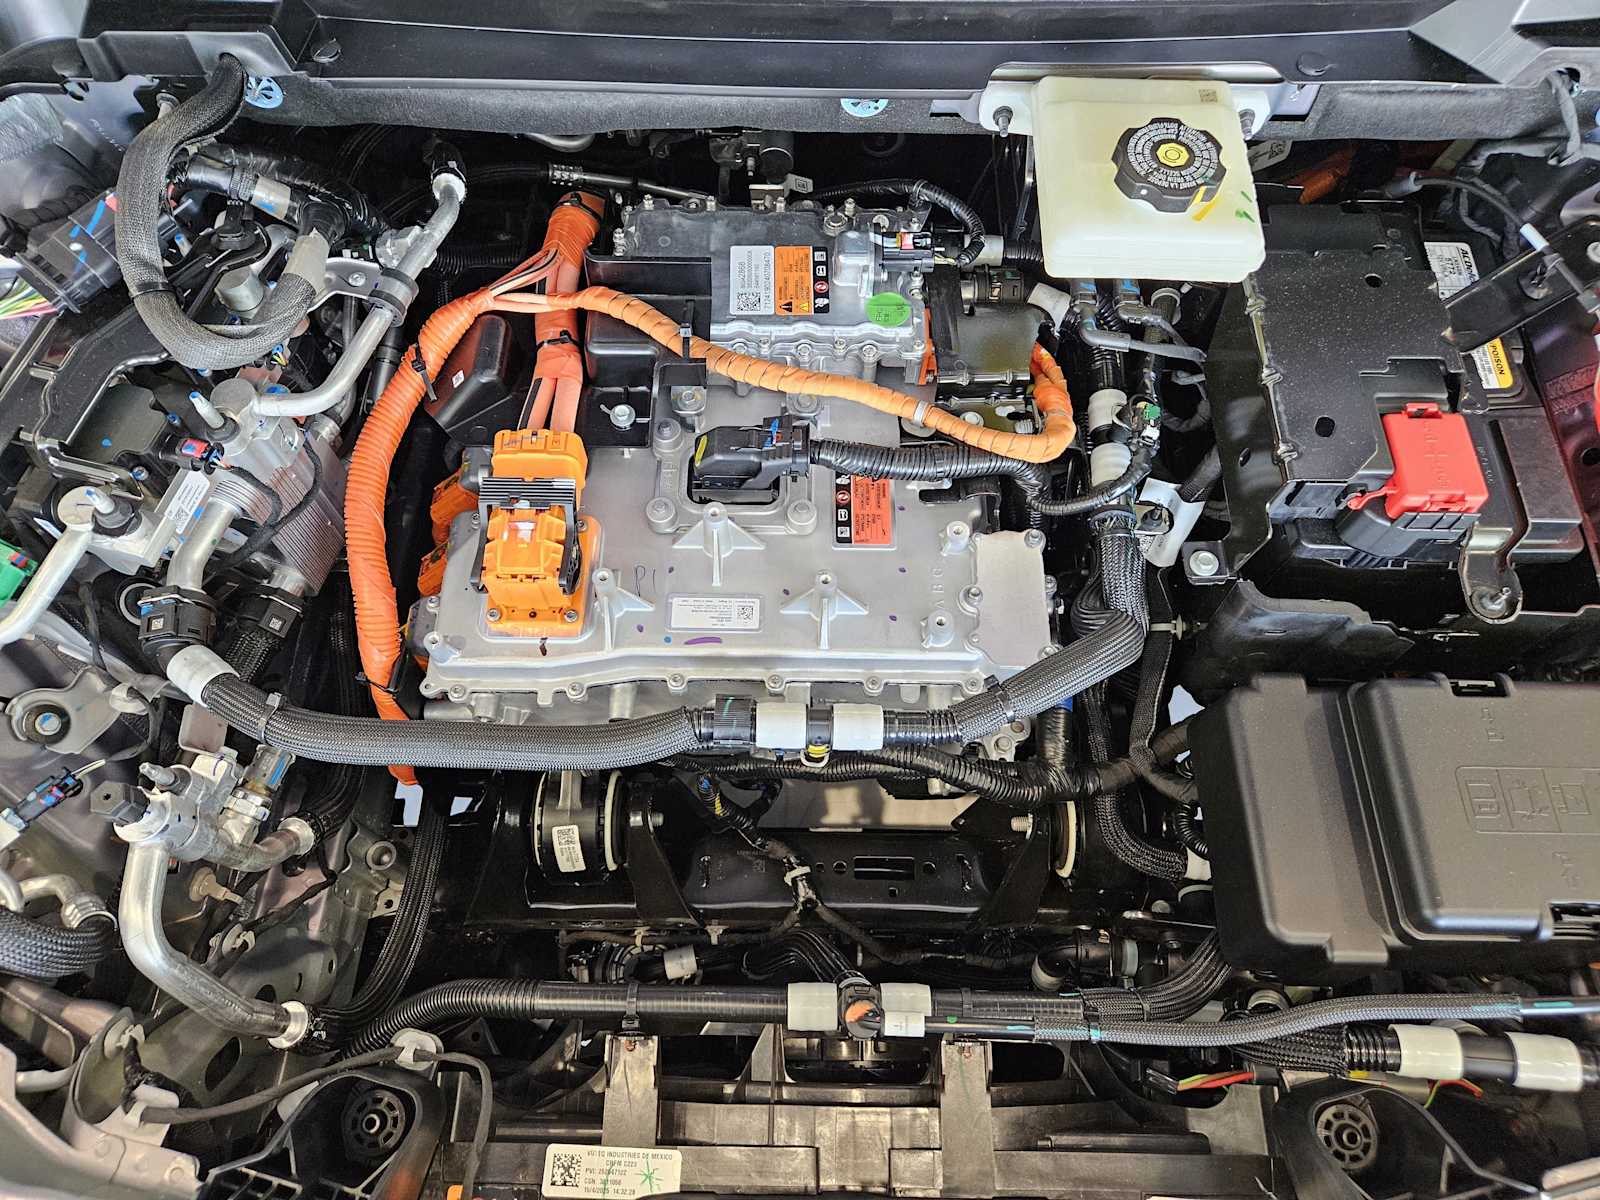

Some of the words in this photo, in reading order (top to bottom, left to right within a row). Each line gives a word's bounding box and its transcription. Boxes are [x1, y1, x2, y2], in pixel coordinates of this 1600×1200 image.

[1489, 344, 1505, 375] POISON
[606, 1151, 641, 1160] INDUSTRIES
[651, 1153, 673, 1161] MEXICO
